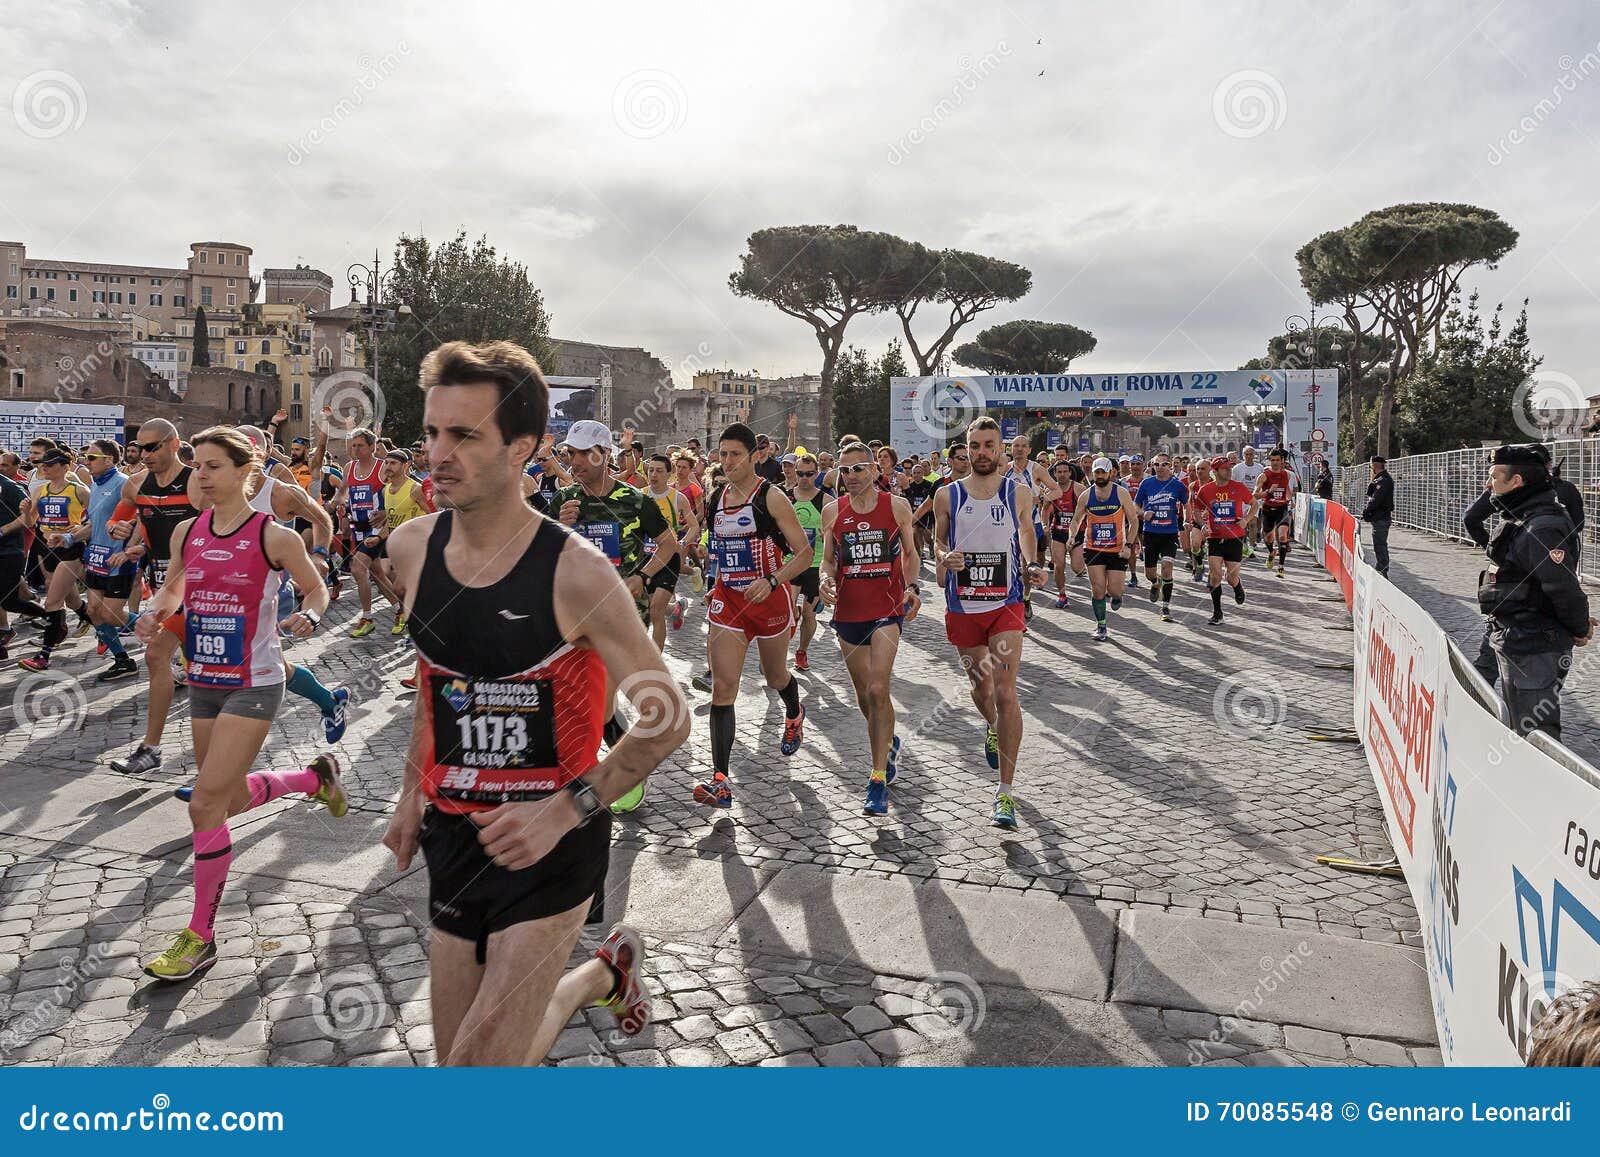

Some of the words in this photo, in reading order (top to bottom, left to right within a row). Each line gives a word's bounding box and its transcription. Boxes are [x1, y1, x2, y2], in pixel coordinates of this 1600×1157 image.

[994, 376, 1095, 392] MARATONA
[1101, 376, 1118, 392] di
[1126, 374, 1183, 392] ROMA
[1191, 373, 1218, 390] 22
[45, 505, 61, 514] F99
[191, 538, 205, 547] 46
[849, 543, 881, 558] 1346
[89, 552, 104, 564] 234
[726, 553, 738, 567] 57
[970, 566, 994, 580] 807
[190, 590, 239, 603] ATLETICA
[195, 634, 226, 656] F69
[474, 682, 539, 695] MARATONA
[456, 714, 529, 752] 1173
[480, 781, 504, 790] new
[504, 779, 556, 791] balance
